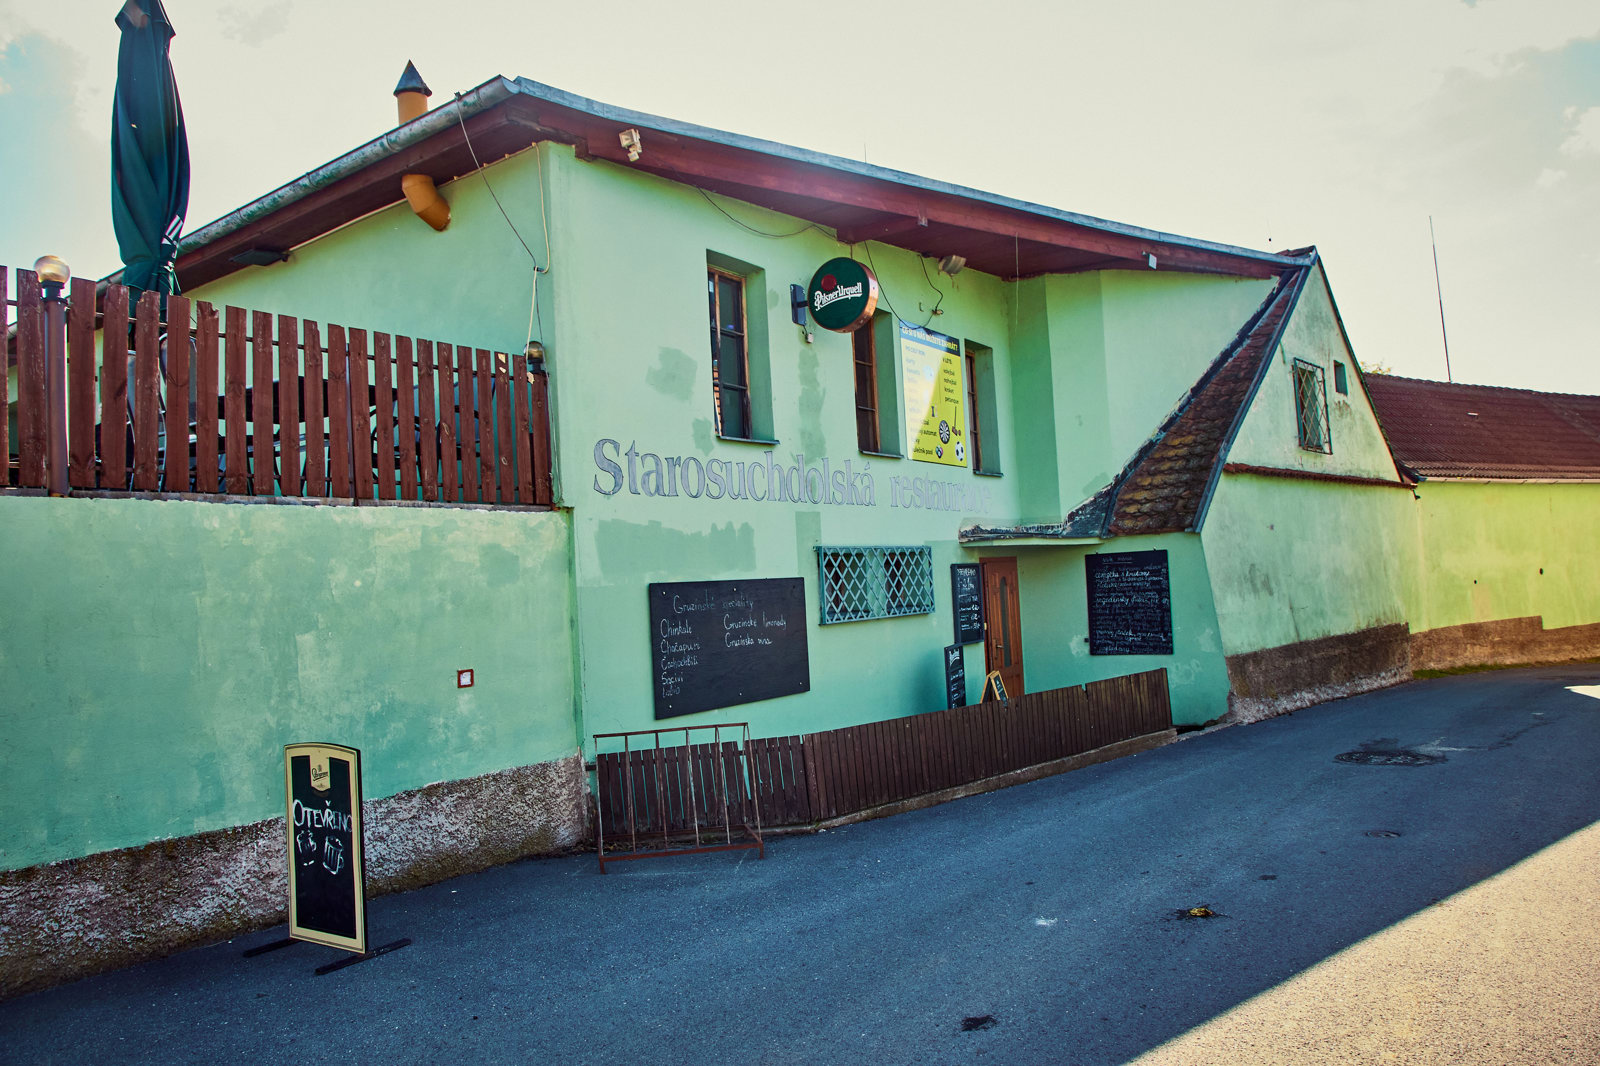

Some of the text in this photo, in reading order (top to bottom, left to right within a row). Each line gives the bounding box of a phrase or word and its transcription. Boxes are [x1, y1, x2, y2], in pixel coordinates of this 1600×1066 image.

[814, 282, 863, 311] Pilsner Urquell
[593, 438, 992, 514] Starosuchdolská restaurace
[292, 799, 353, 832] OTEVŘENO
